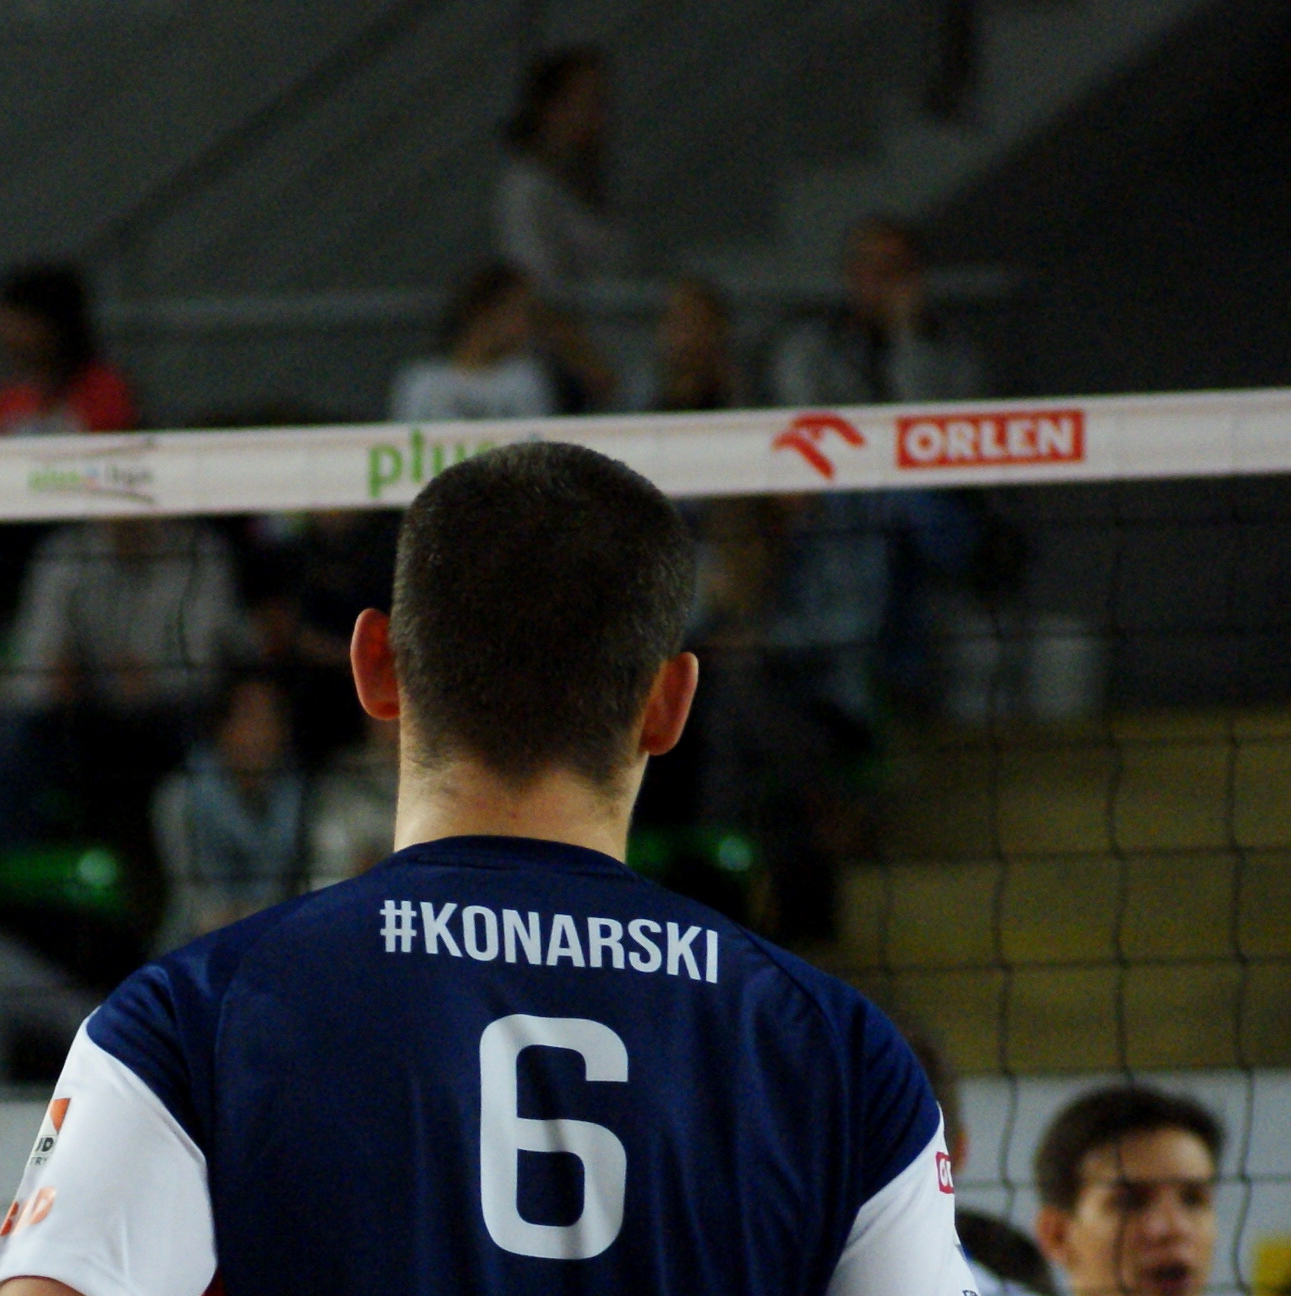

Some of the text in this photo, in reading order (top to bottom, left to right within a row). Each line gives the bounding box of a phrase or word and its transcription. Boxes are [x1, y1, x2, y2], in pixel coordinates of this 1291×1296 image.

[905, 415, 1076, 464] ORLEN
[380, 900, 719, 984] #KONARSKI
[479, 1014, 629, 1260] 6
